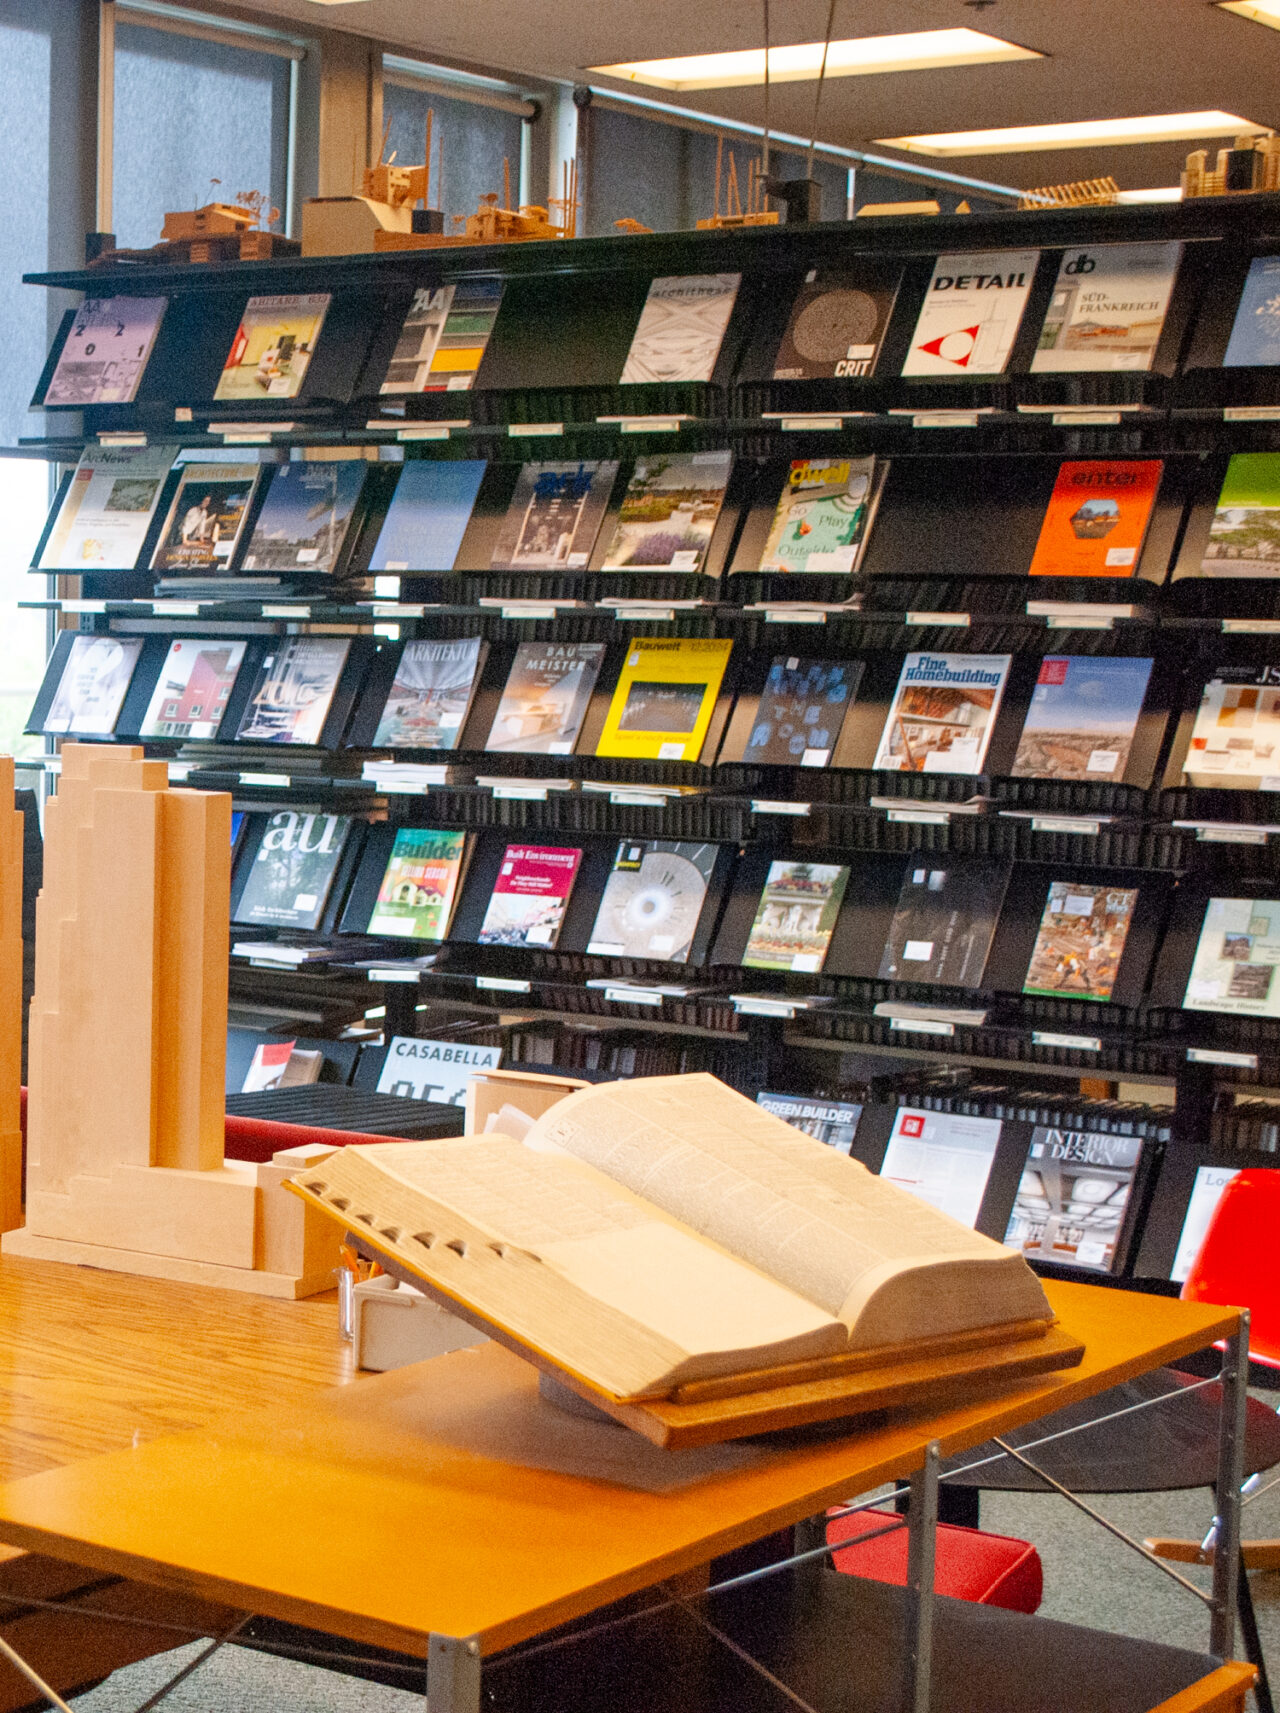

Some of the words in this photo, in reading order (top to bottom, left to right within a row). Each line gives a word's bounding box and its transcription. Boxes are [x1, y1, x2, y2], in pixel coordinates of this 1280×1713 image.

[1064, 254, 1096, 275] db
[933, 273, 1026, 291] DETAIL
[1079, 302, 1160, 312] FRANKREICH
[834, 360, 872, 377] CRIT
[789, 463, 851, 485] dwell
[818, 515, 849, 529] Play
[546, 646, 577, 657] BAU
[634, 641, 681, 652] Bauwelt
[526, 660, 587, 671] MEISTER
[917, 656, 948, 670] Fine
[905, 668, 1002, 686] Homebuilding
[263, 810, 339, 853] au
[394, 841, 464, 861] Builder
[395, 1042, 493, 1067] CASABELLA
[761, 1100, 803, 1117] GREEN
[801, 1105, 855, 1123] BUILDER
[1045, 1128, 1130, 1153] INTERIOR
[1051, 1143, 1119, 1166] DESIGN
